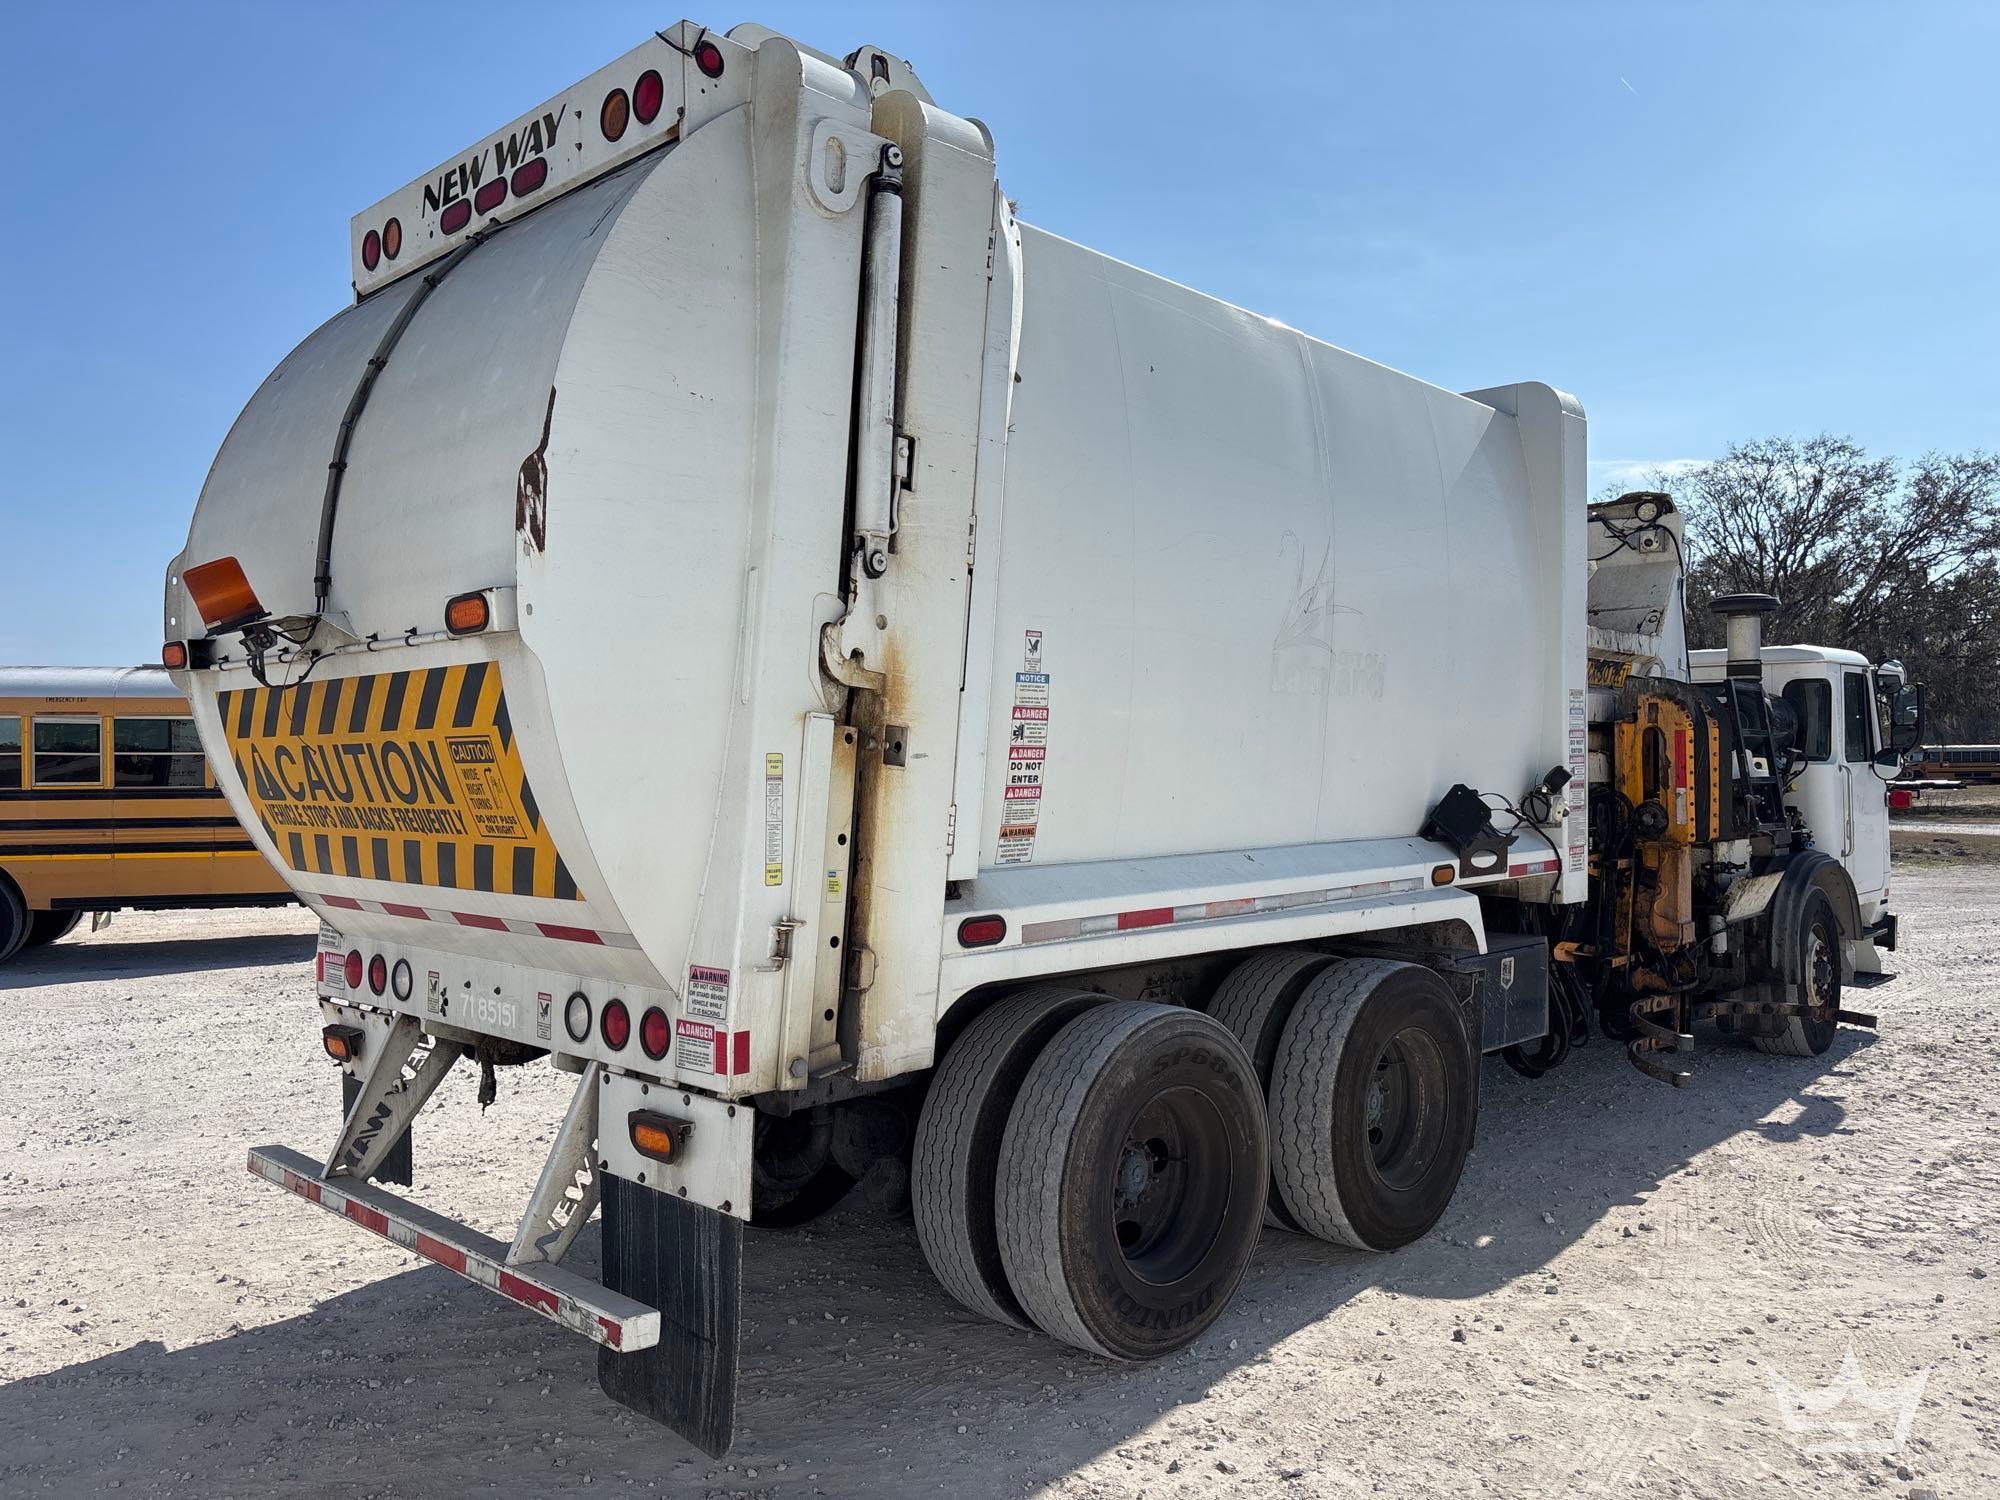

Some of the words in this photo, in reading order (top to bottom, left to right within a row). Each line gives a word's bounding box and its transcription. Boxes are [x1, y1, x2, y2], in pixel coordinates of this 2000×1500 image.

[421, 148, 489, 219] NEW
[494, 103, 567, 176] WAY
[1020, 674, 1046, 683] NOTICE
[1021, 708, 1048, 719] DANGER
[451, 743, 493, 761] CAUTION
[1018, 748, 1045, 759] DANGER
[1010, 762, 1023, 771] DO
[1025, 762, 1042, 771] NOT
[274, 740, 455, 805] CAUTION
[461, 768, 480, 780] WIDE
[1011, 775, 1039, 783] ENTER
[465, 783, 486, 795] RIGHT
[1014, 788, 1040, 799] DANGER
[265, 803, 307, 826] VEHICLE
[303, 805, 338, 829] STOPS
[333, 805, 359, 829] AND
[354, 806, 395, 832] BACKS
[391, 807, 469, 836] FREQUENTLY
[475, 814, 484, 823] DO
[485, 815, 498, 824] NOT
[495, 825, 516, 834] RIGHT
[1008, 828, 1035, 837] WARNING
[699, 970, 728, 985] WARNING
[696, 991, 710, 999] STAND
[710, 993, 727, 1001] BEHIND
[685, 1023, 713, 1040] DANGER
